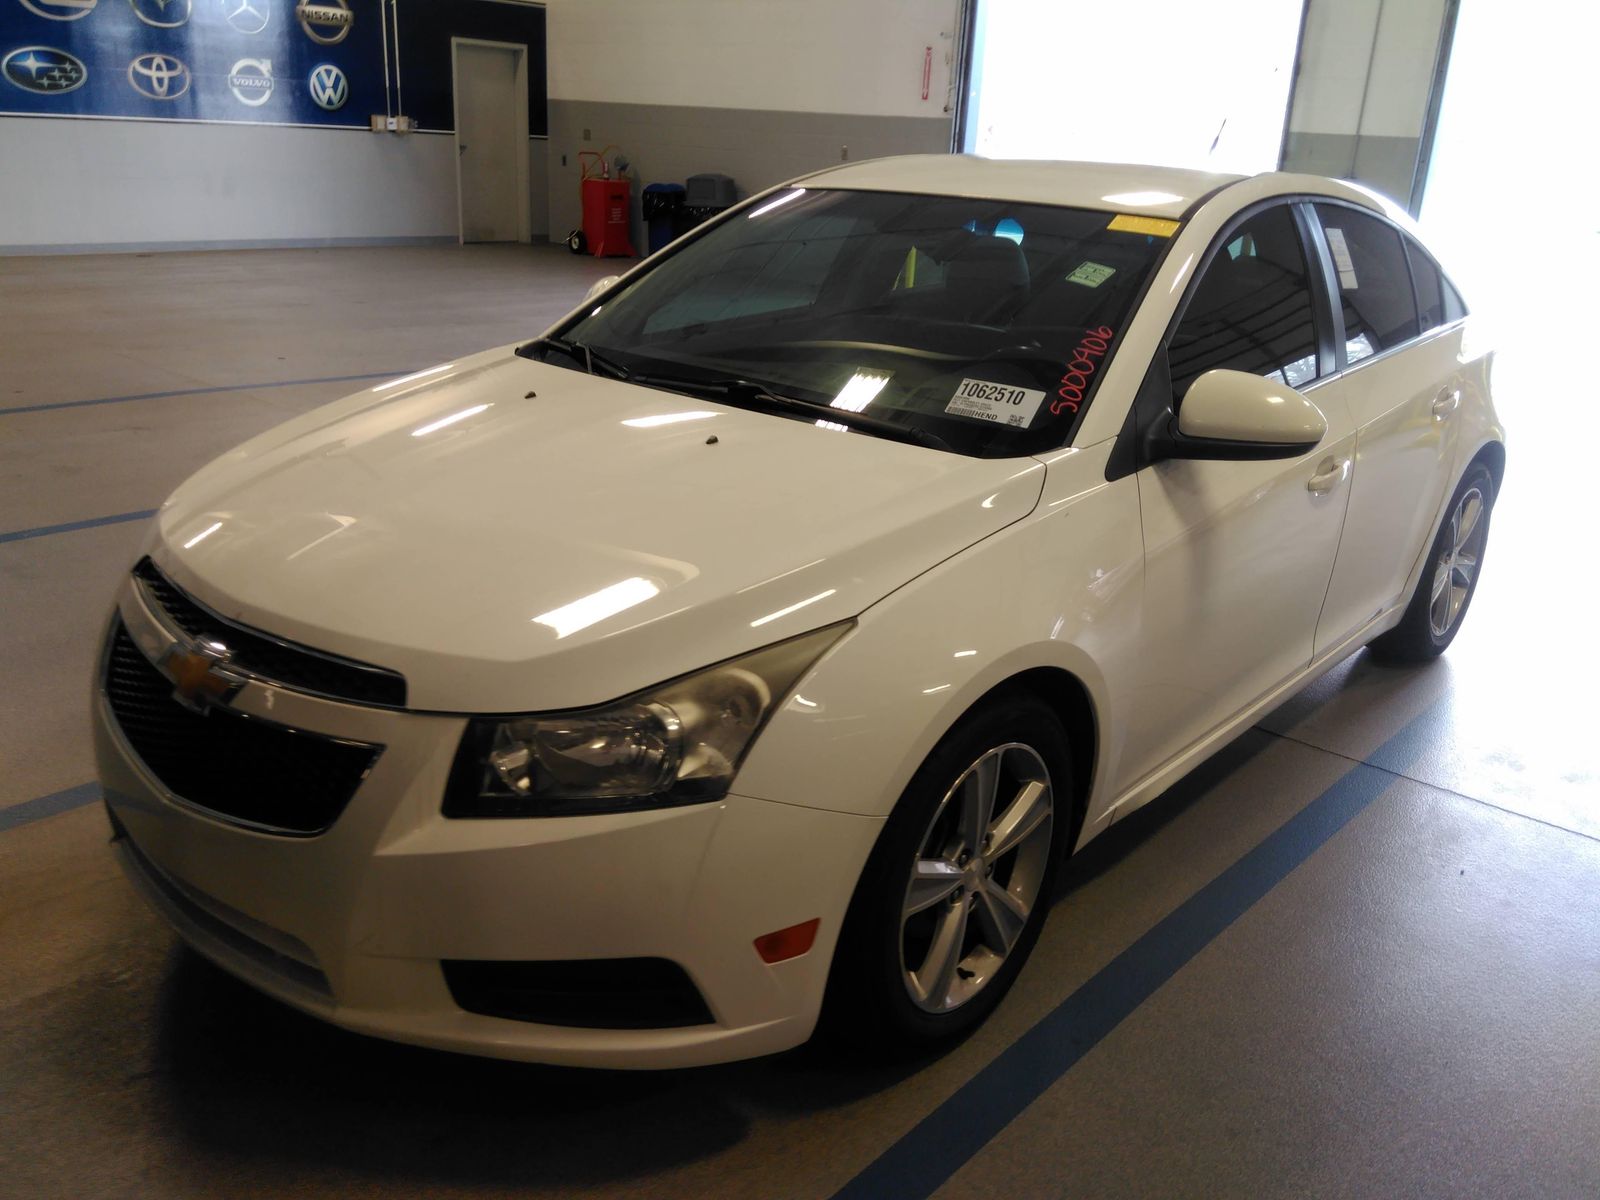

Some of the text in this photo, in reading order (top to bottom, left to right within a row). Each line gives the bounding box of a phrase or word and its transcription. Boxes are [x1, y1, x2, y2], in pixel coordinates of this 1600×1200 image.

[302, 9, 348, 22] NISSAN
[232, 78, 270, 87] VOLVO
[961, 382, 1026, 405] 1062510
[974, 411, 998, 421] HEND
